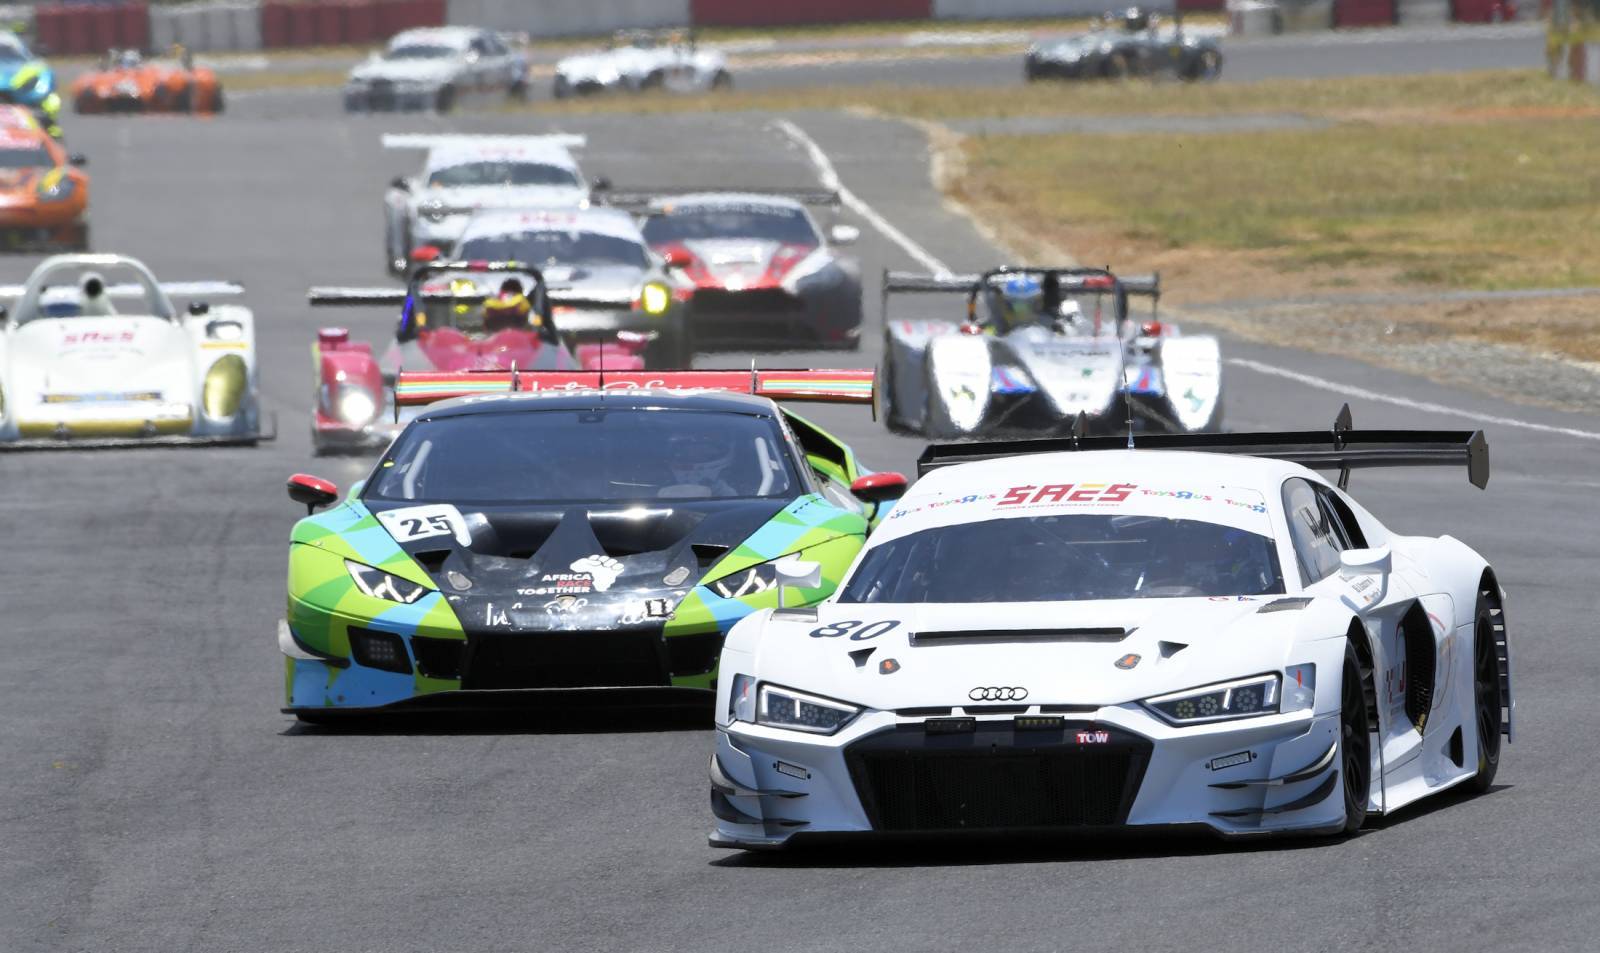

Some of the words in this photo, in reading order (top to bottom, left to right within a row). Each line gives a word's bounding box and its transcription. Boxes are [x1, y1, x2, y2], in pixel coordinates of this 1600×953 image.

[400, 513, 452, 537] 25
[541, 573, 593, 582] AFRICA
[516, 586, 591, 596] TOGETHER
[808, 619, 902, 642] 80
[1077, 732, 1109, 744] TOW
